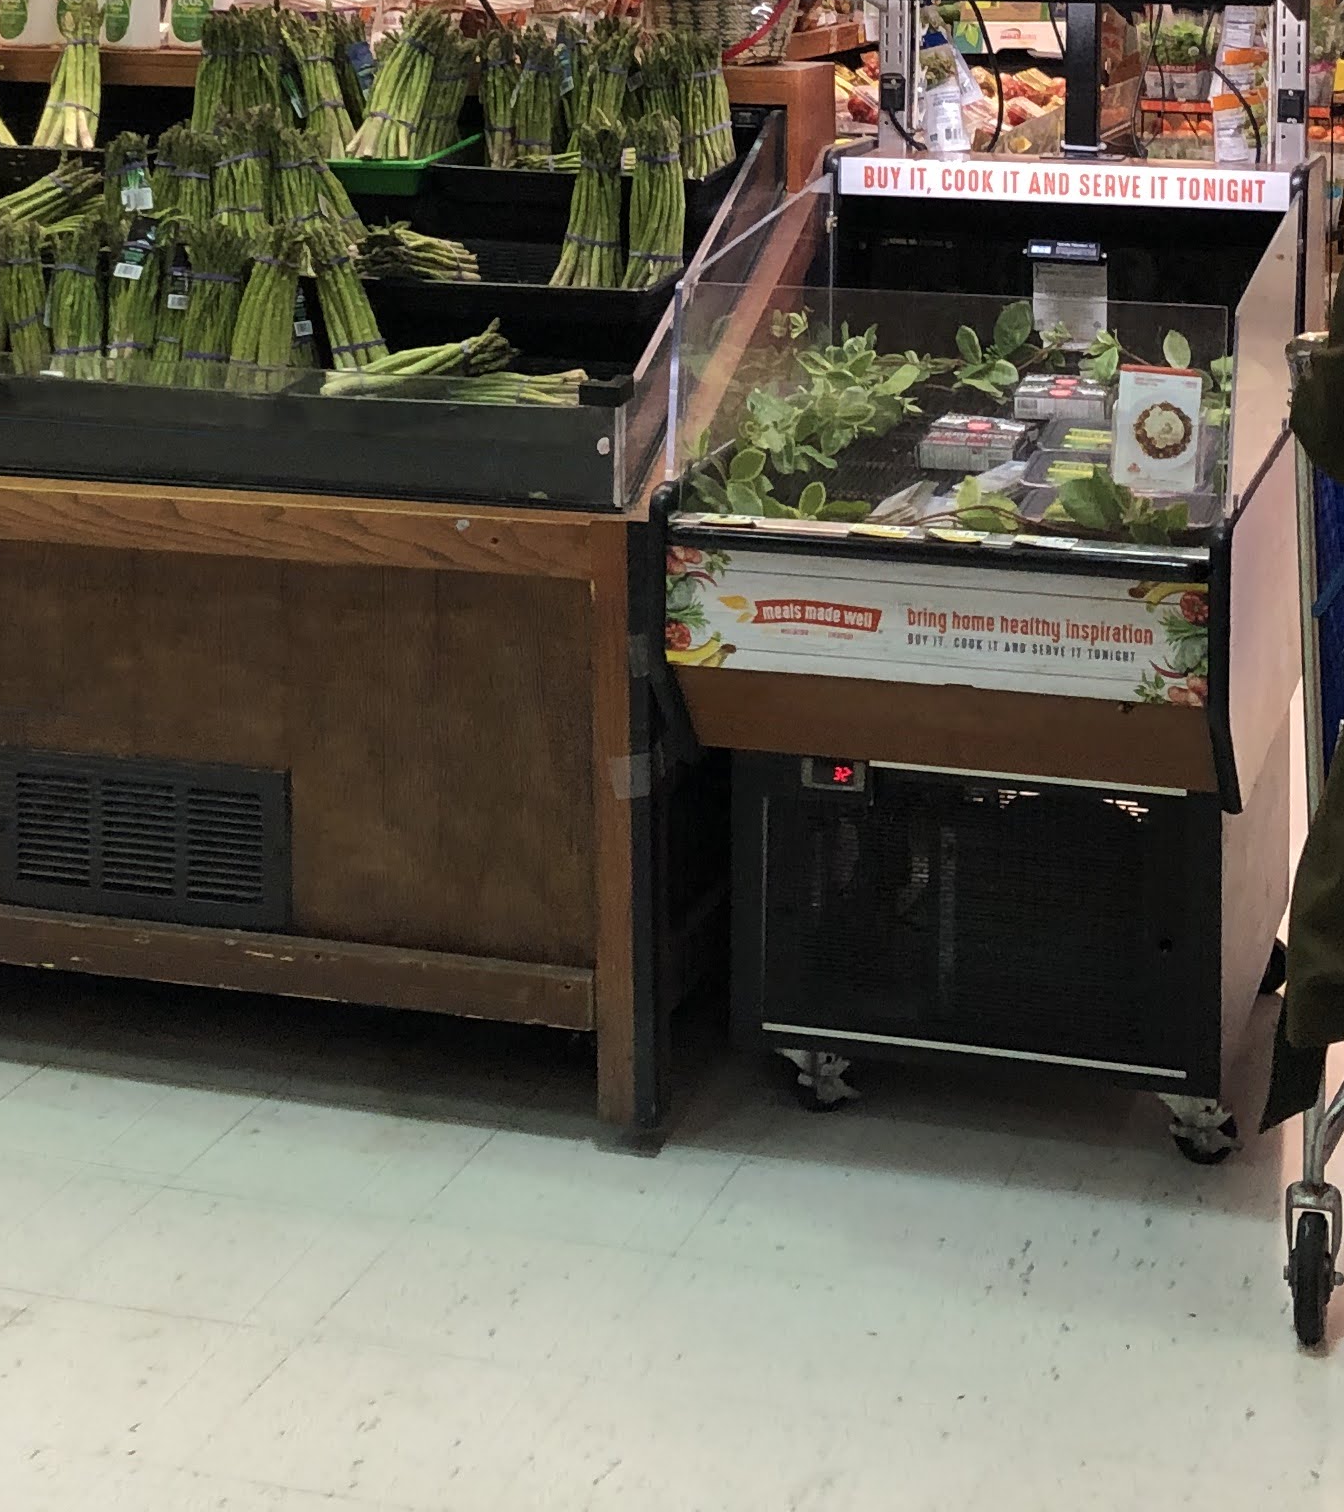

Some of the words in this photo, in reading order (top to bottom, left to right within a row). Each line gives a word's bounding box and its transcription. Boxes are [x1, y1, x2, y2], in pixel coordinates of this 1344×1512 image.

[863, 165, 901, 191] BUY
[910, 167, 932, 194] IT,
[942, 168, 994, 193] COOK
[1003, 170, 1019, 194] IT
[1028, 172, 1069, 196] AND
[1080, 174, 1141, 200] SERVE
[1150, 176, 1168, 201] IT
[1176, 177, 1267, 204] TONIGHT
[763, 603, 802, 620] meals
[806, 604, 841, 623] made
[844, 609, 873, 628] well
[908, 607, 947, 634] bring
[952, 610, 995, 633] home
[1000, 614, 1061, 643] healthy
[1066, 618, 1154, 646] inspiration
[907, 633, 928, 645] BUY
[953, 637, 983, 650] COOK
[988, 640, 998, 652] IT
[1004, 641, 1026, 653] AND
[1031, 643, 1065, 656] SERVE
[1087, 648, 1136, 662] TONIGHT
